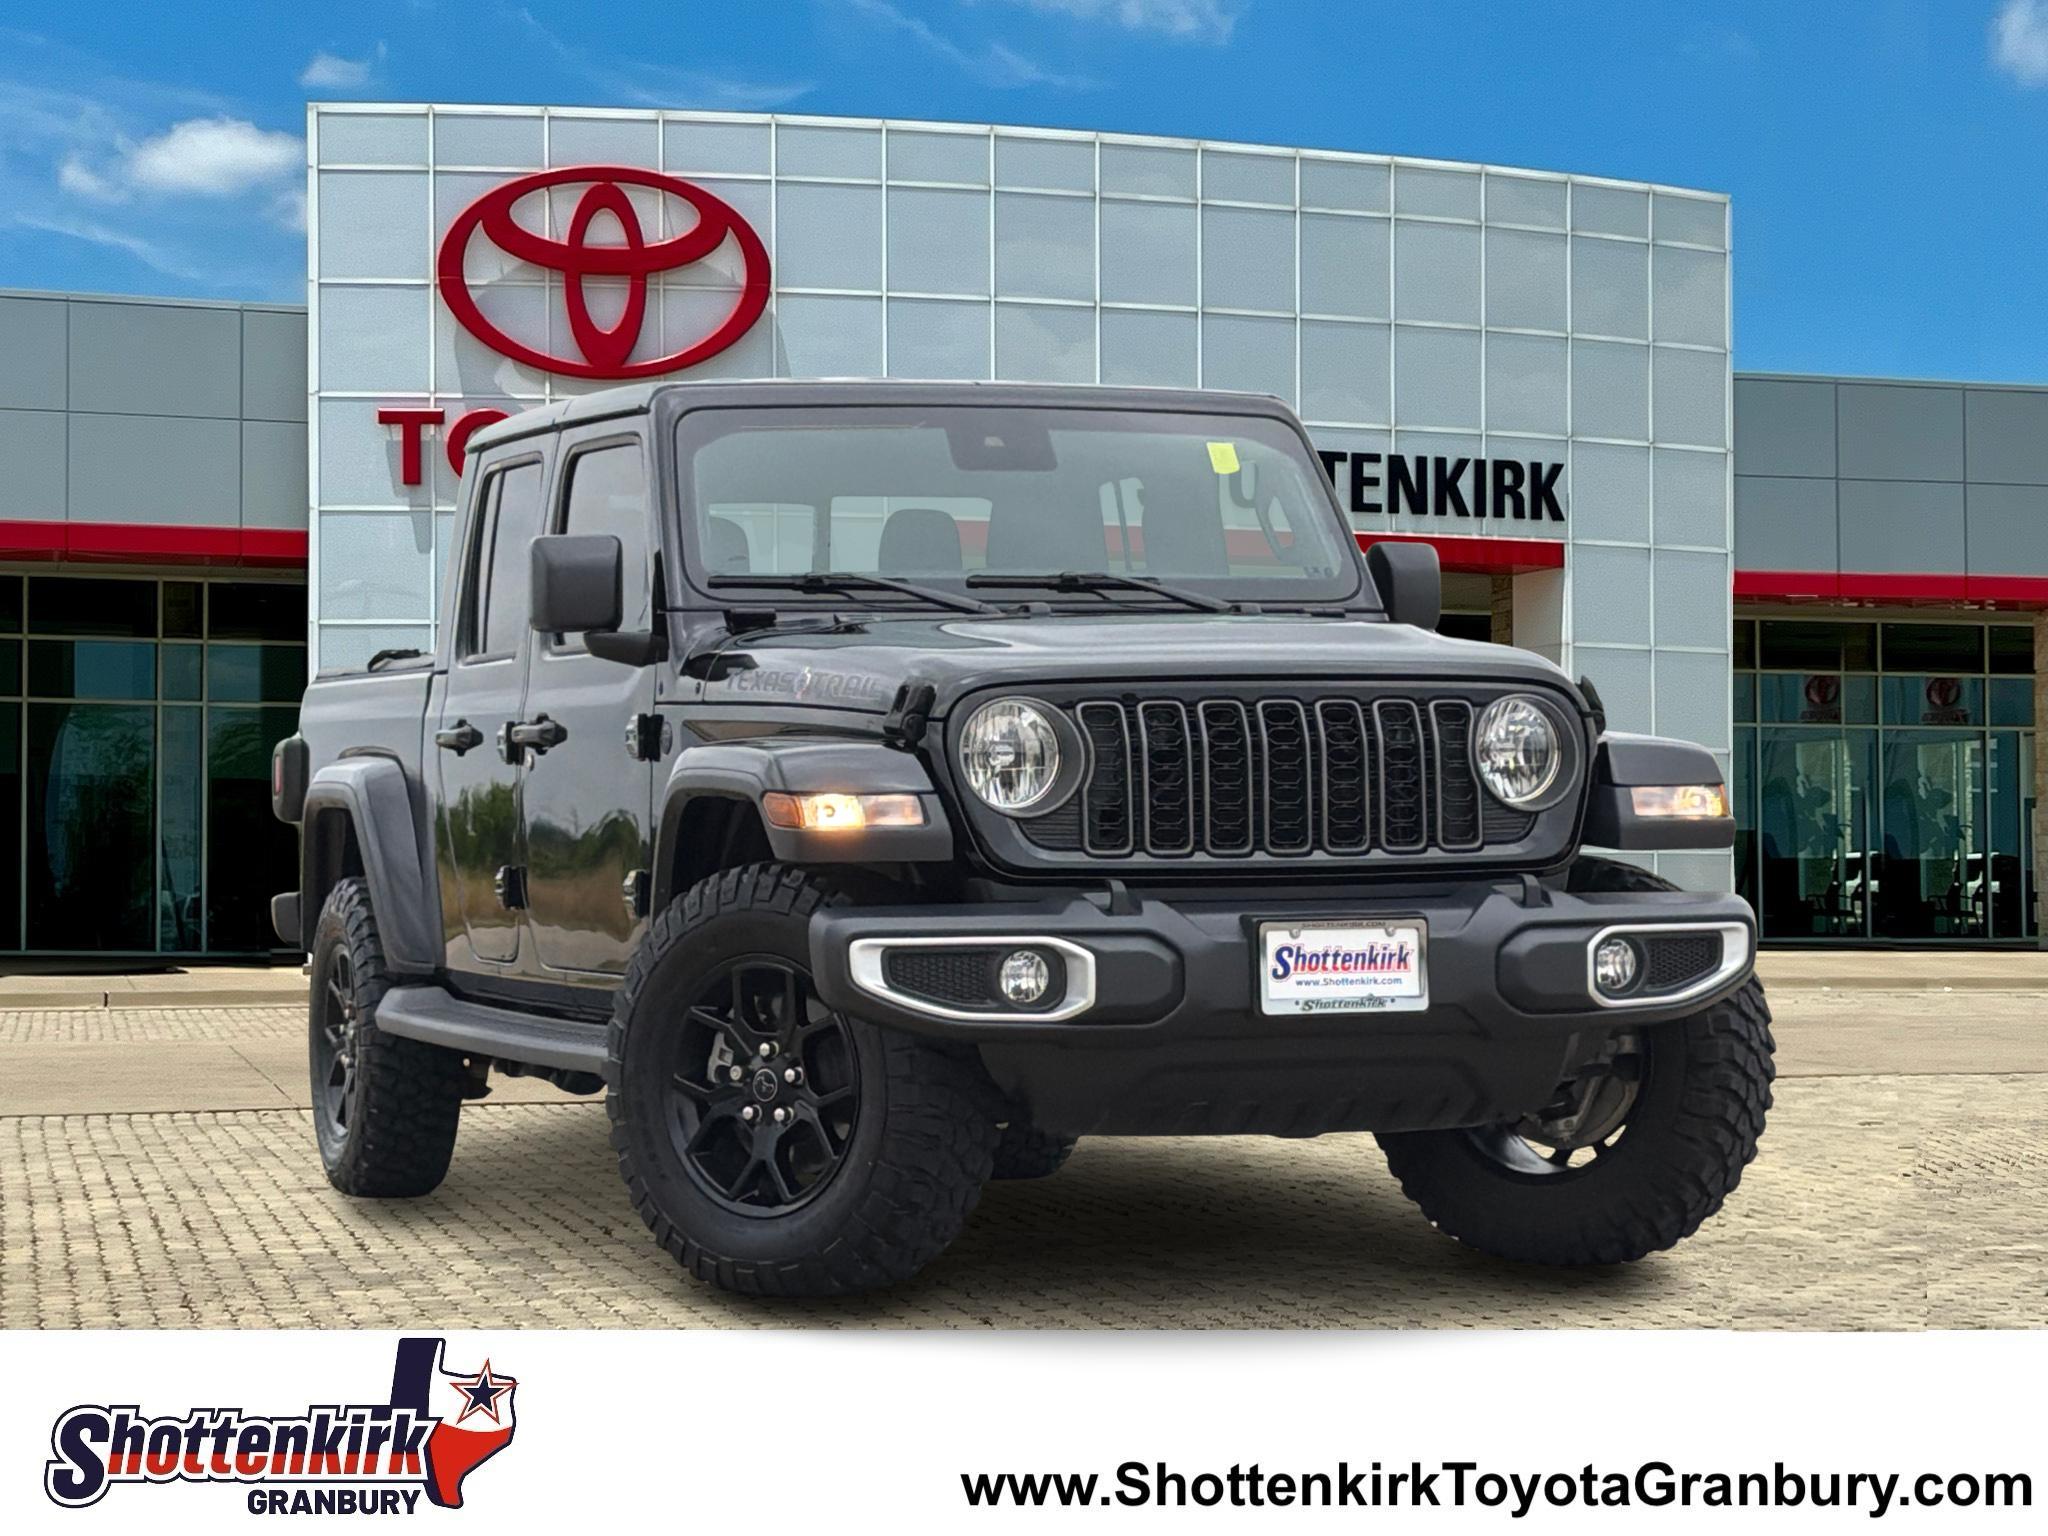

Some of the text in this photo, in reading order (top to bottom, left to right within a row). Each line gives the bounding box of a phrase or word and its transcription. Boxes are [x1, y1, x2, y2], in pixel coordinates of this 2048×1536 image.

[1271, 942, 1412, 981] Shottenkirk
[1295, 976, 1403, 987] www.Shottenkirk.com
[1300, 997, 1387, 1012] Shottenkirk
